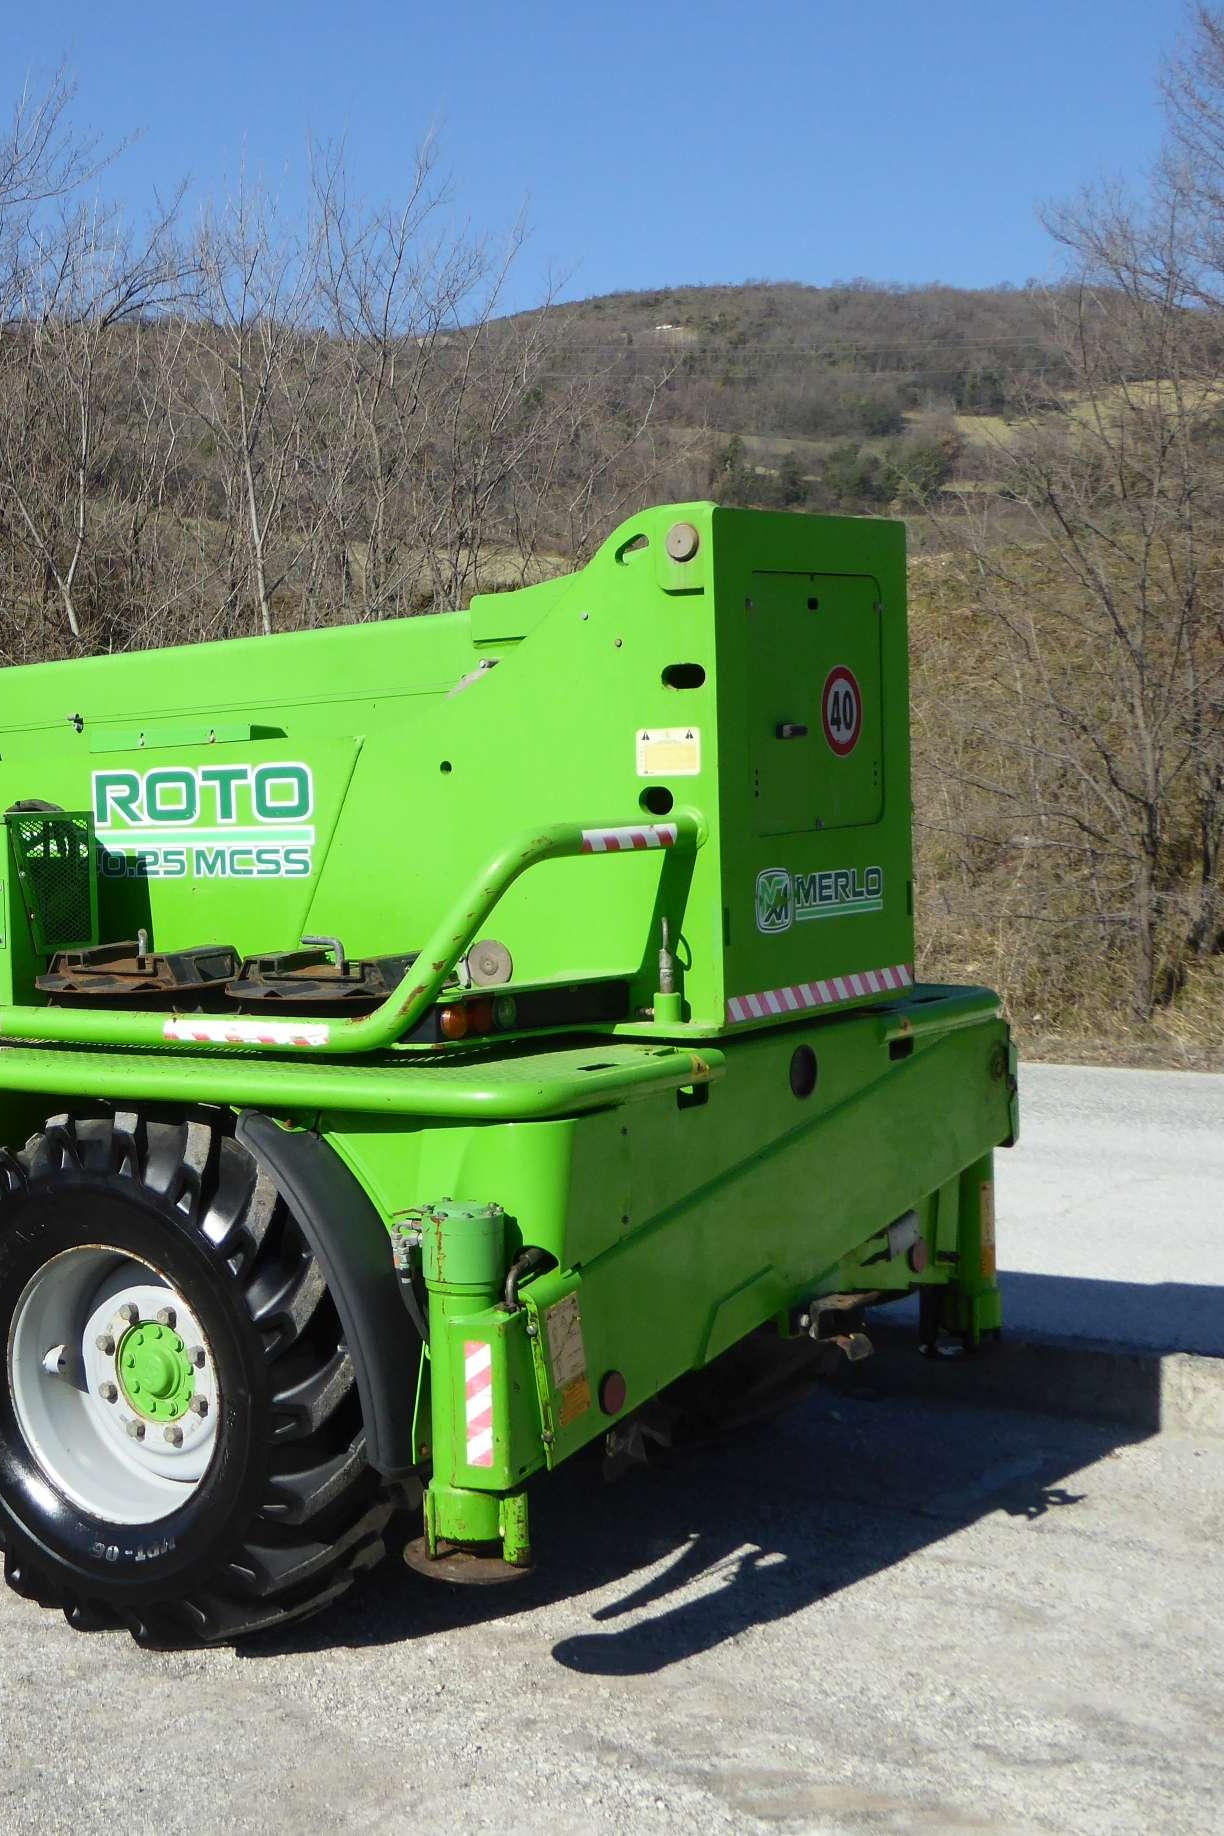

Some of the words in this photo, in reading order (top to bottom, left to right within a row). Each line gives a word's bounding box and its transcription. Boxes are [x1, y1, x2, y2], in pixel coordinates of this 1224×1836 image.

[830, 690, 854, 732] 40
[92, 762, 313, 826] ROTO
[96, 847, 186, 878] 0.25
[194, 846, 313, 878] MCSS
[795, 867, 882, 907] MERLO
